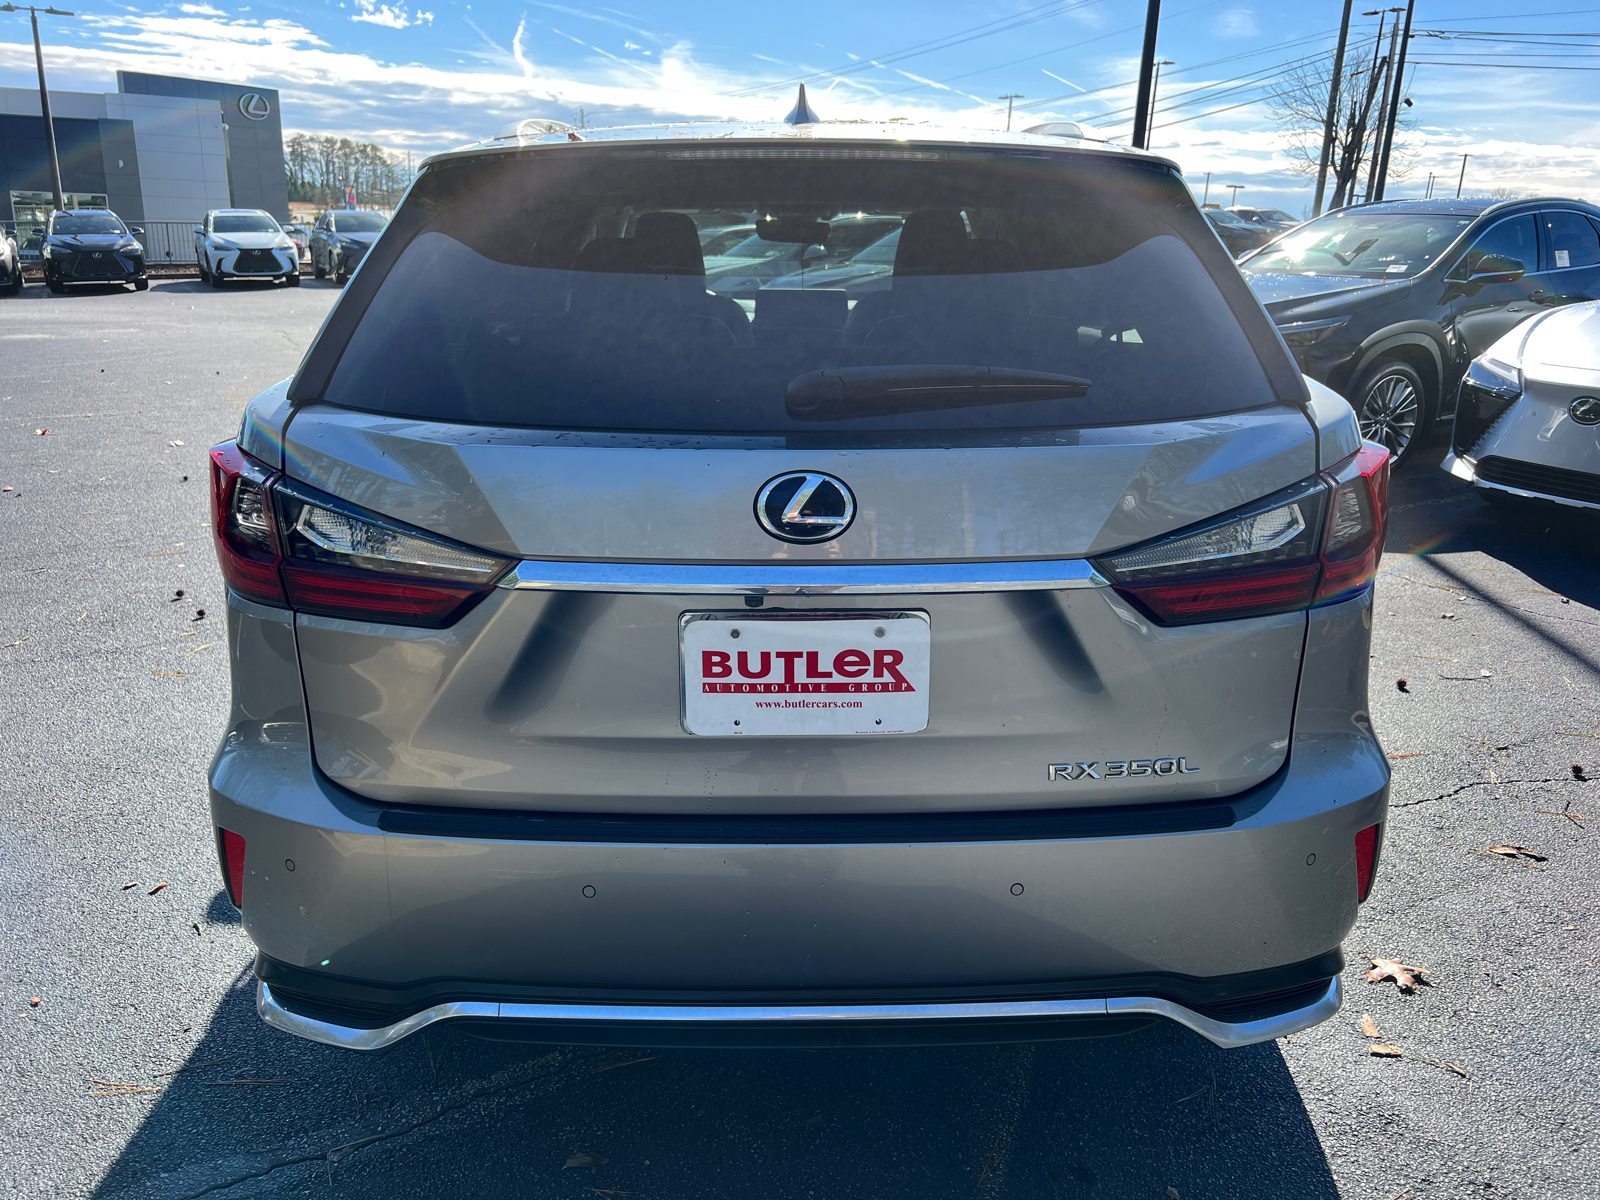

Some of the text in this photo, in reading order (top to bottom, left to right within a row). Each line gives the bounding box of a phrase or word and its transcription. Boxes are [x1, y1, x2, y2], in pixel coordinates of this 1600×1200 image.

[703, 682, 909, 692] AUTOMOTIVE GROUP
[755, 699, 863, 709] www.butlercars.com
[1048, 757, 1201, 781] RX 350L
